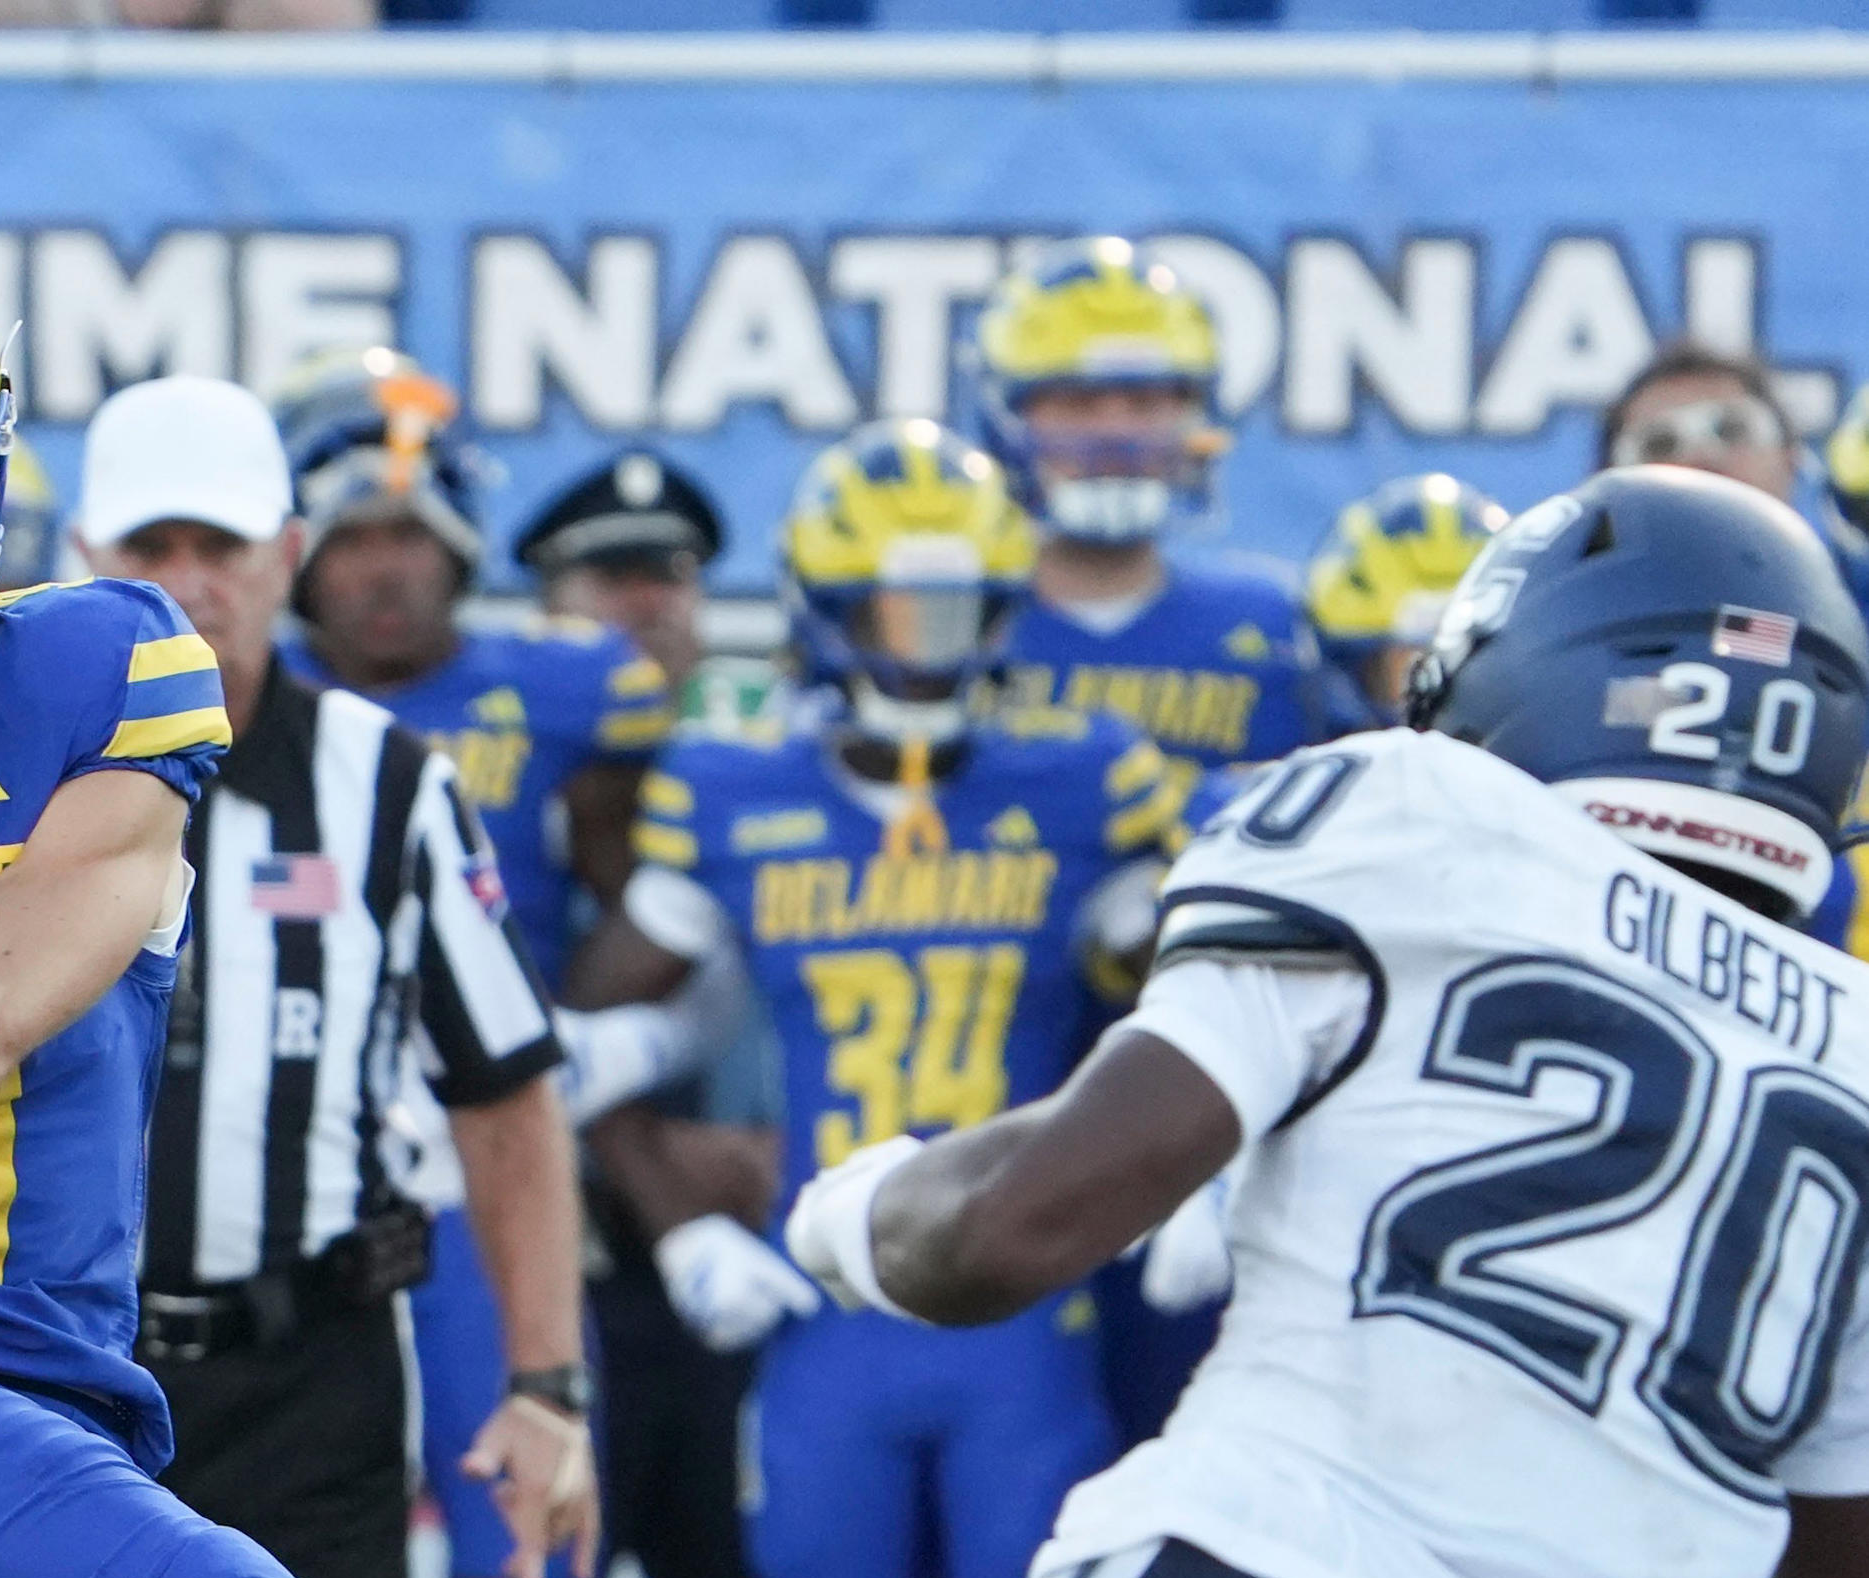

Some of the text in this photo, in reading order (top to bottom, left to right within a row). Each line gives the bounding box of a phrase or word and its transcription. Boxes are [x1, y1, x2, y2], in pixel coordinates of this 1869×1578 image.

[462, 226, 1845, 440] NATONAL
[1648, 661, 1817, 776] 20
[276, 989, 320, 1058] R
[801, 943, 1026, 1168] 34
[1606, 872, 1848, 1063] GILBERT
[1351, 953, 1869, 1510] 20
